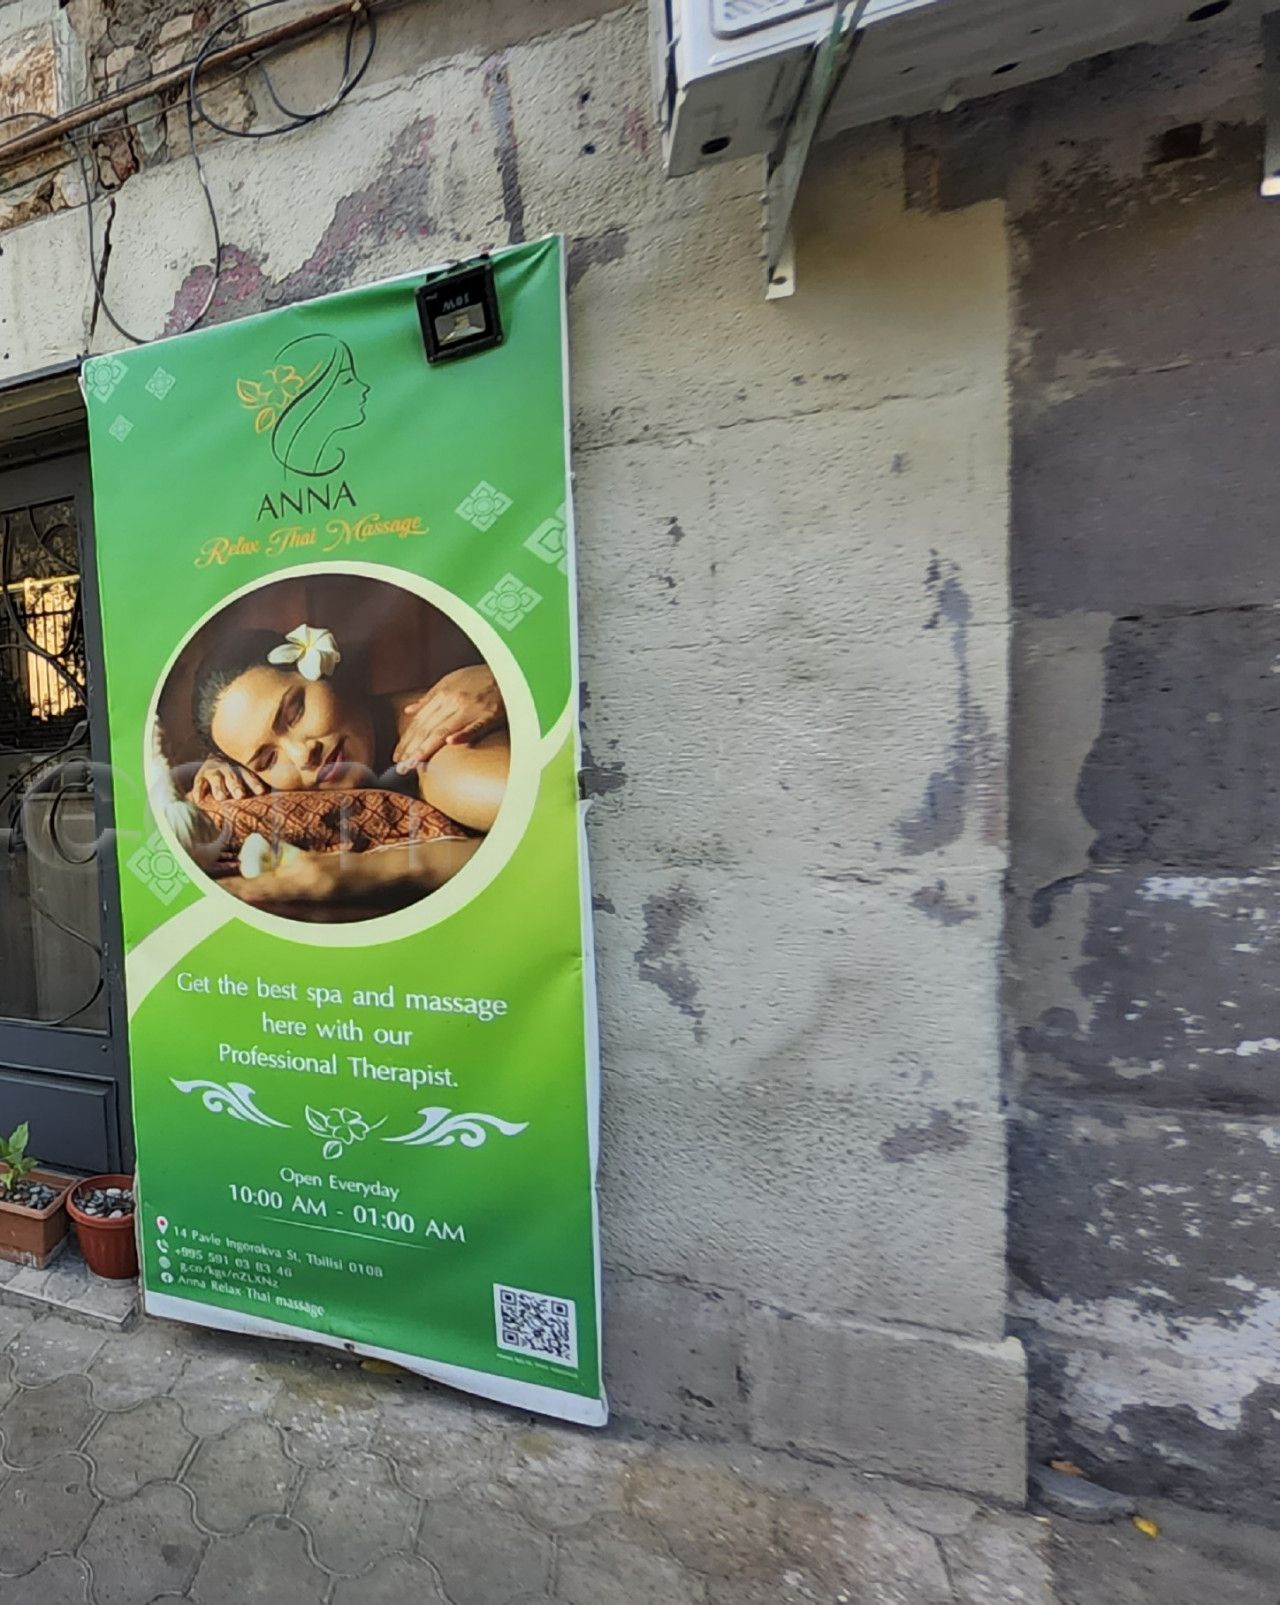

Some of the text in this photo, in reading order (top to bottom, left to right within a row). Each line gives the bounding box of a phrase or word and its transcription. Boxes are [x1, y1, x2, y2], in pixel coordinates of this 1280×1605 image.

[256, 479, 357, 523] ANNA
[193, 513, 430, 569] Relax Thai Massage
[176, 971, 508, 1022] Get the best spa and massage
[261, 1011, 413, 1047] here with our
[218, 1043, 459, 1091] Professional Therapist.
[278, 1166, 400, 1203] Open Everyday
[227, 1183, 284, 1210] 10:00
[291, 1195, 328, 1218] AM
[352, 1204, 416, 1234] 01:00
[424, 1218, 466, 1244] AM
[173, 1225, 188, 1240] 14
[192, 1229, 221, 1247] Pavle
[225, 1236, 282, 1259] Ingorokva
[305, 1252, 343, 1271] Tbilisi
[348, 1262, 384, 1278] 0108
[175, 1246, 203, 1261] +995
[207, 1251, 229, 1266] 591
[177, 1274, 326, 1319] Anna Relax Thai massage
